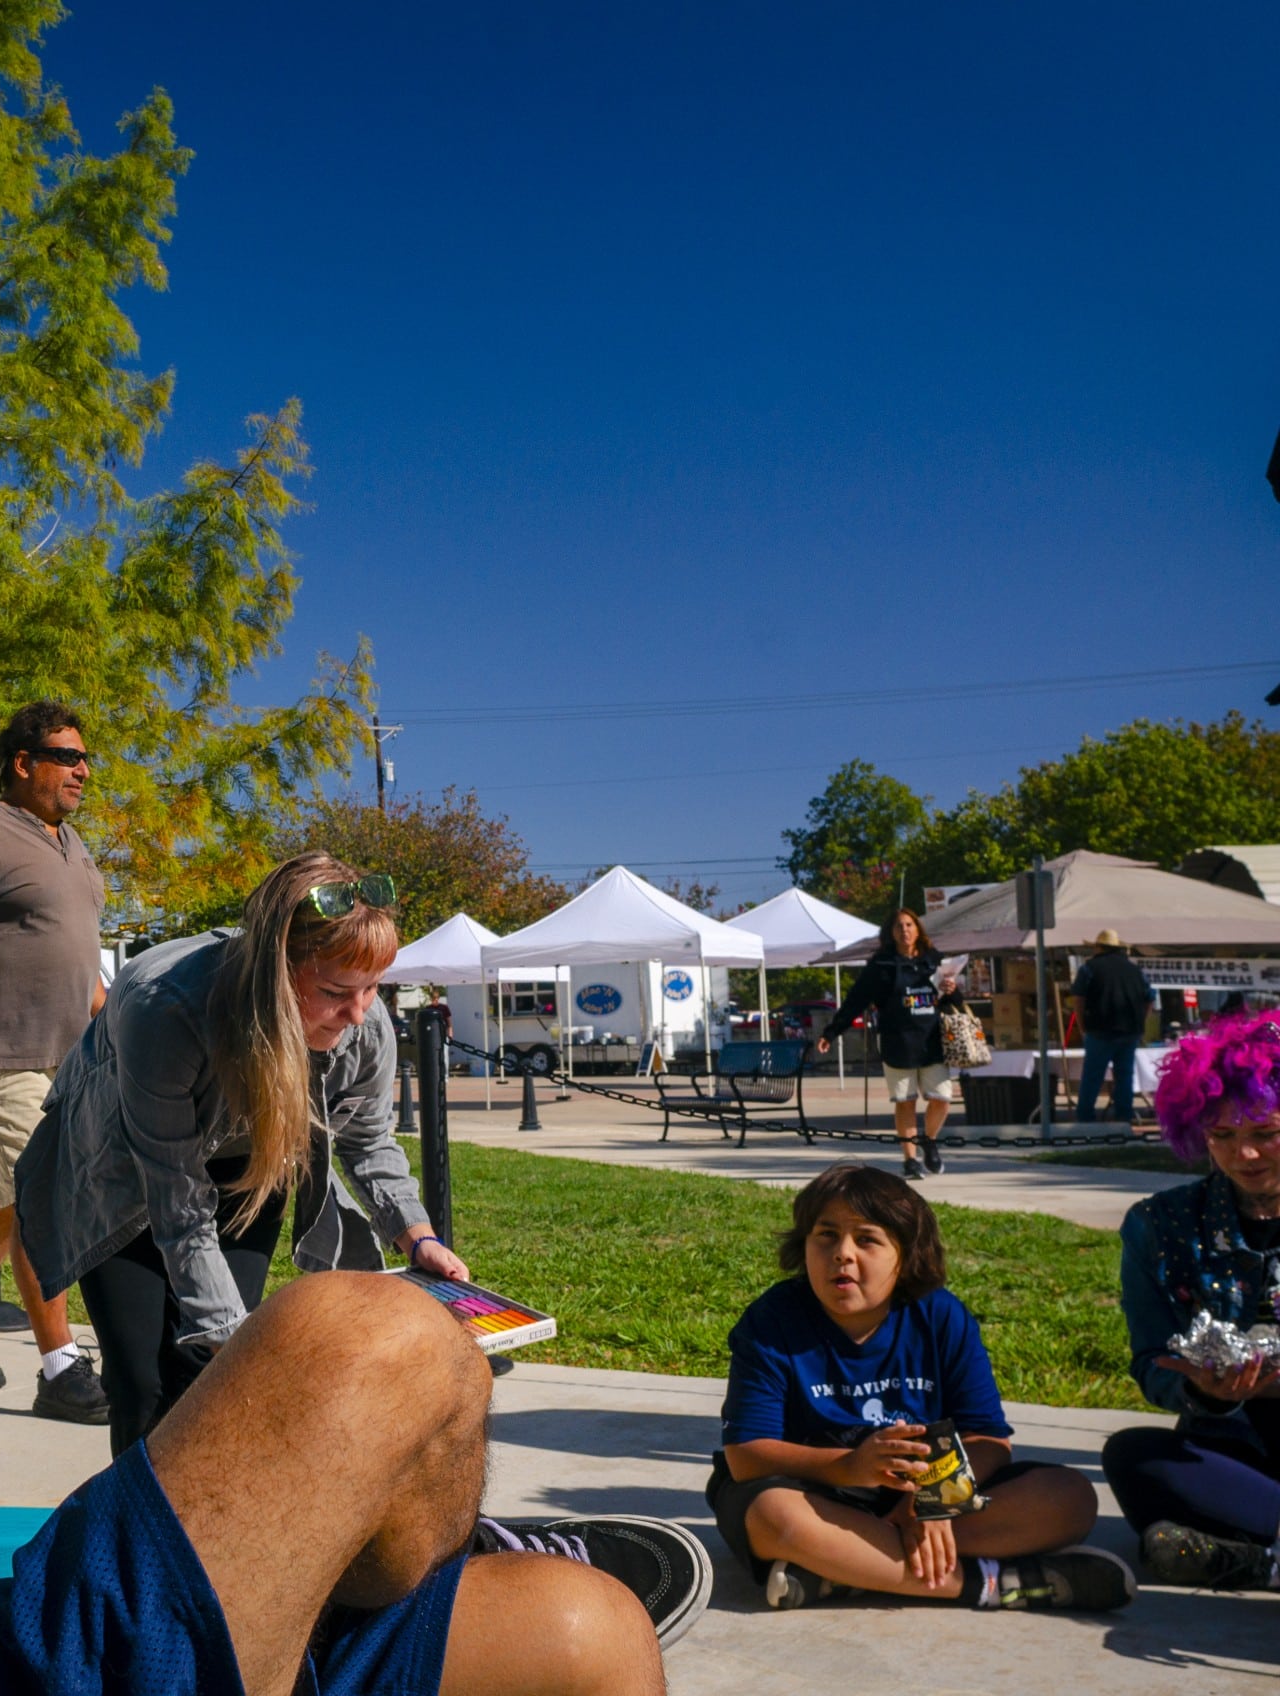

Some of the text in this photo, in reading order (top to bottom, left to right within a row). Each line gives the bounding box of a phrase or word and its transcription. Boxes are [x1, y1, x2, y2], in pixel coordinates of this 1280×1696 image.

[1211, 974, 1253, 985] TEXAS
[810, 1383, 835, 1398] I'M
[841, 1377, 901, 1398] HAVING
